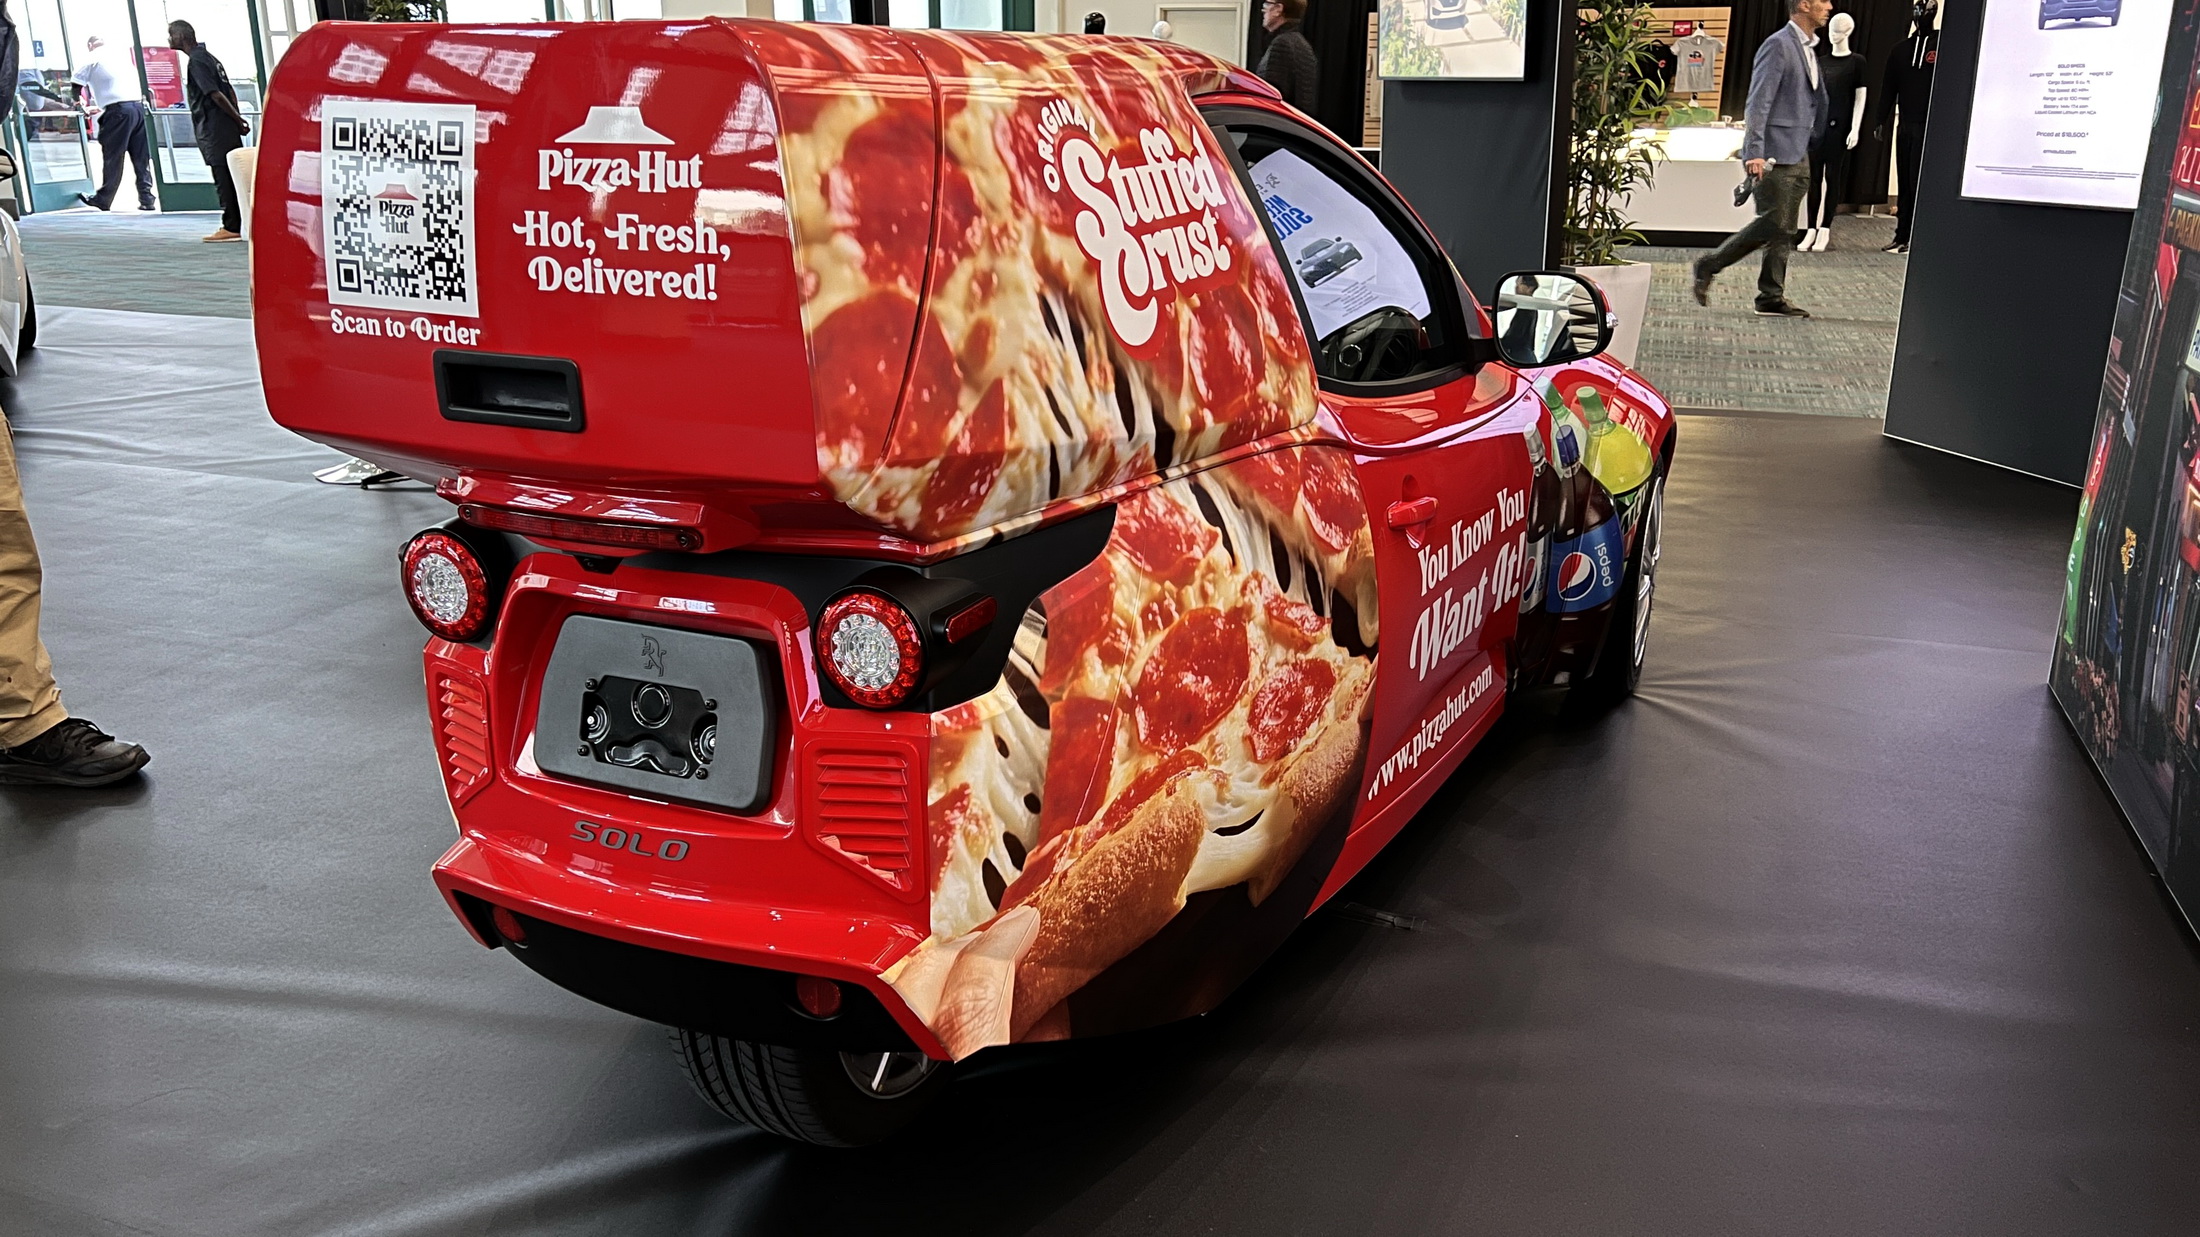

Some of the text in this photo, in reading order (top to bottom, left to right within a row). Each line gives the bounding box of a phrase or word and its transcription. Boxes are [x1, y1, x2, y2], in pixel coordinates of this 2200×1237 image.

[1038, 98, 1099, 193] ORIGINAL
[538, 147, 704, 193] Pizza Hut
[1061, 124, 1227, 260] Stuffed
[379, 199, 415, 219] Pizza
[380, 215, 410, 235] Hut
[512, 210, 731, 262] Hot, Fresh,
[527, 255, 718, 301] Delivered!
[1099, 205, 1231, 347] Crust
[330, 308, 481, 346] Scan to Order
[1417, 487, 1525, 598] You Know You
[1594, 541, 1614, 588] pepsi
[1409, 530, 1526, 682] Want It!
[569, 820, 690, 862] SOLO
